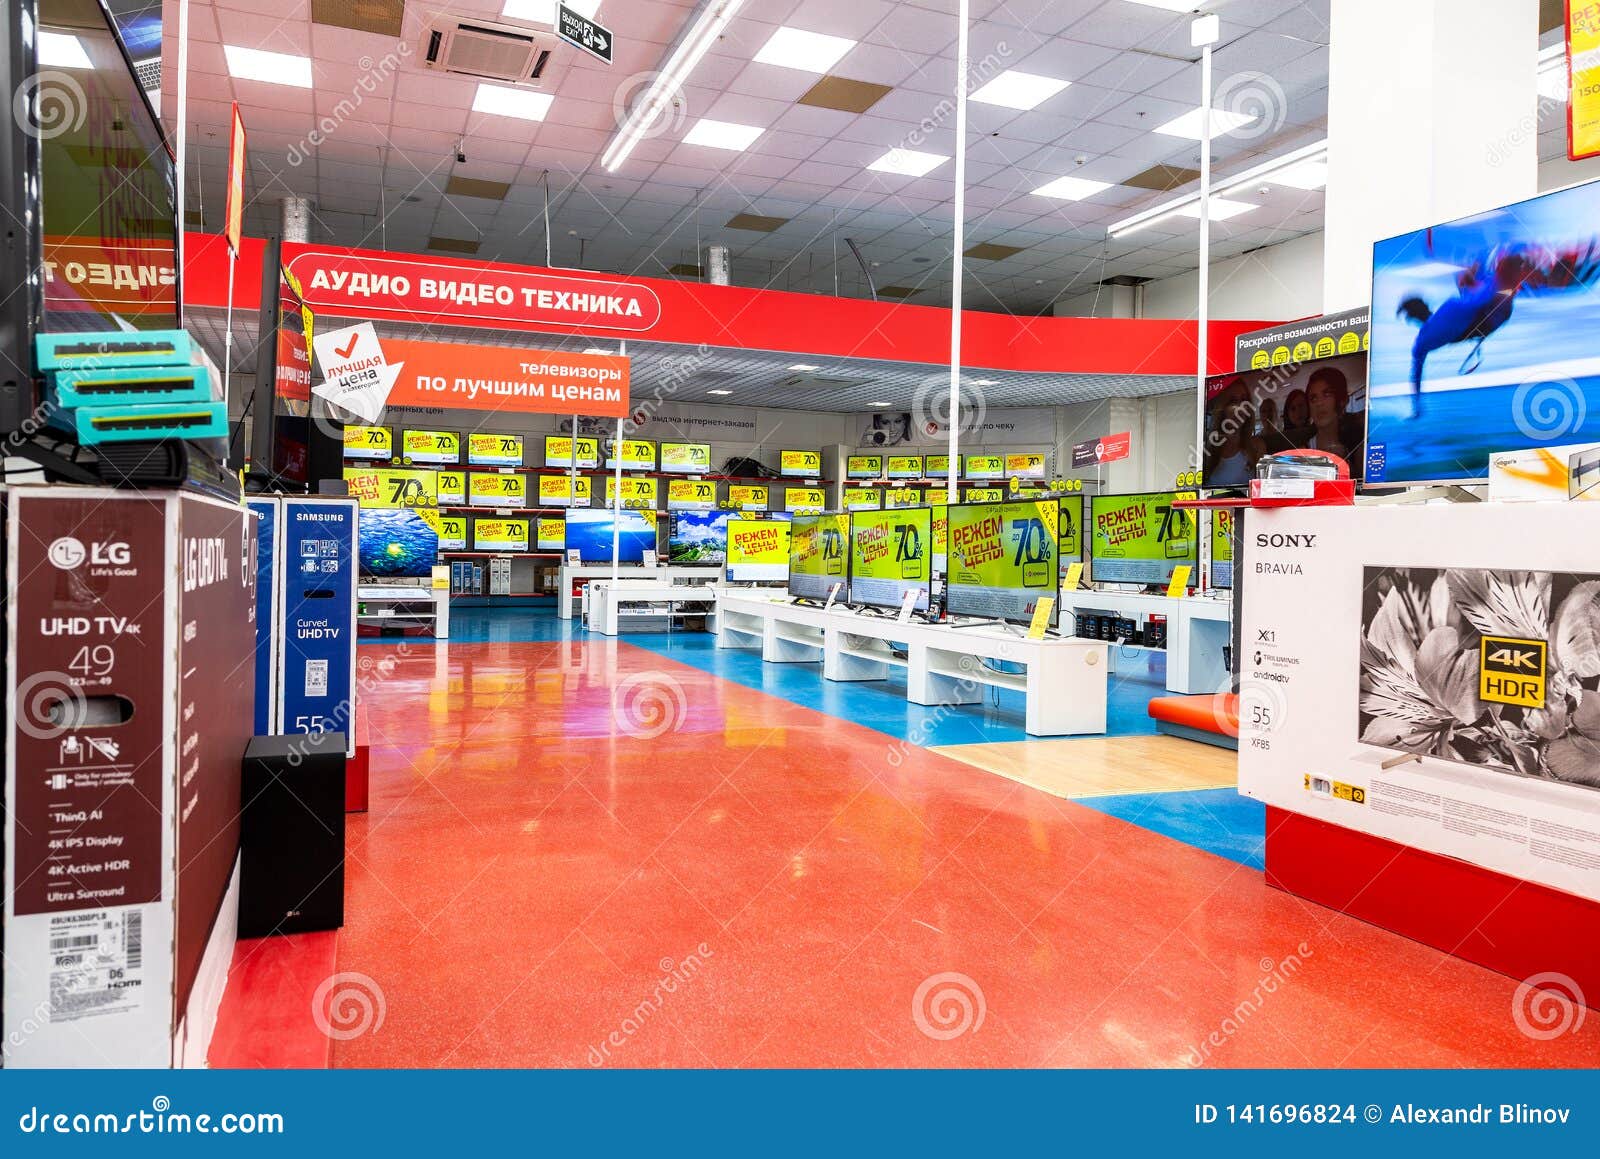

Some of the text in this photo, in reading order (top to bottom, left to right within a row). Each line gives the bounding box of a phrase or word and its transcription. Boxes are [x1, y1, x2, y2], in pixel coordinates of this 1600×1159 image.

[562, 12, 582, 34] ВЫХОД
[1572, 2, 1600, 25] РЕ
[566, 26, 579, 38] EXIT
[310, 269, 643, 317] АУДИО ВИДЕО ТЕХНИКА
[1239, 334, 1283, 349] Раскройте
[1284, 321, 1348, 341] возможности
[328, 356, 383, 379] ЛУЧШАЯ
[519, 361, 622, 384] телевизоры
[339, 369, 378, 387] цена
[416, 376, 622, 403] по лучшим ценам
[386, 405, 444, 415] ренных цен
[652, 415, 755, 428] выдача интернет-заказов
[996, 423, 1015, 431] чеку
[296, 512, 344, 522] SAMSUNG
[1097, 503, 1147, 529] РЕЖЕМ
[735, 528, 778, 545] РЕЖЕМ
[857, 521, 889, 548] РЕЖЕМ
[953, 515, 1004, 549] РЕЖЕМ
[1256, 533, 1316, 548] SONY
[894, 524, 924, 563] 70%
[1012, 518, 1051, 566] 70%
[91, 542, 131, 565] LG
[91, 568, 138, 576] Life's Good
[184, 538, 197, 592] LG
[198, 538, 215, 587] UHD
[1255, 562, 1303, 575] BRAVIA
[40, 618, 91, 636] UHD
[297, 618, 328, 628] Curved
[297, 628, 340, 639] UHD TV
[69, 645, 115, 676] 49
[1488, 648, 1539, 669] 4K
[1486, 676, 1539, 701] HDR
[296, 715, 324, 734] 55
[1253, 705, 1271, 725] 55
[54, 810, 103, 823] ThinQ AI
[48, 835, 124, 849] 4K IPS Display
[48, 860, 131, 876] 4K Active HDR
[47, 886, 125, 902] Ultra Surround
[109, 968, 124, 980] D6
